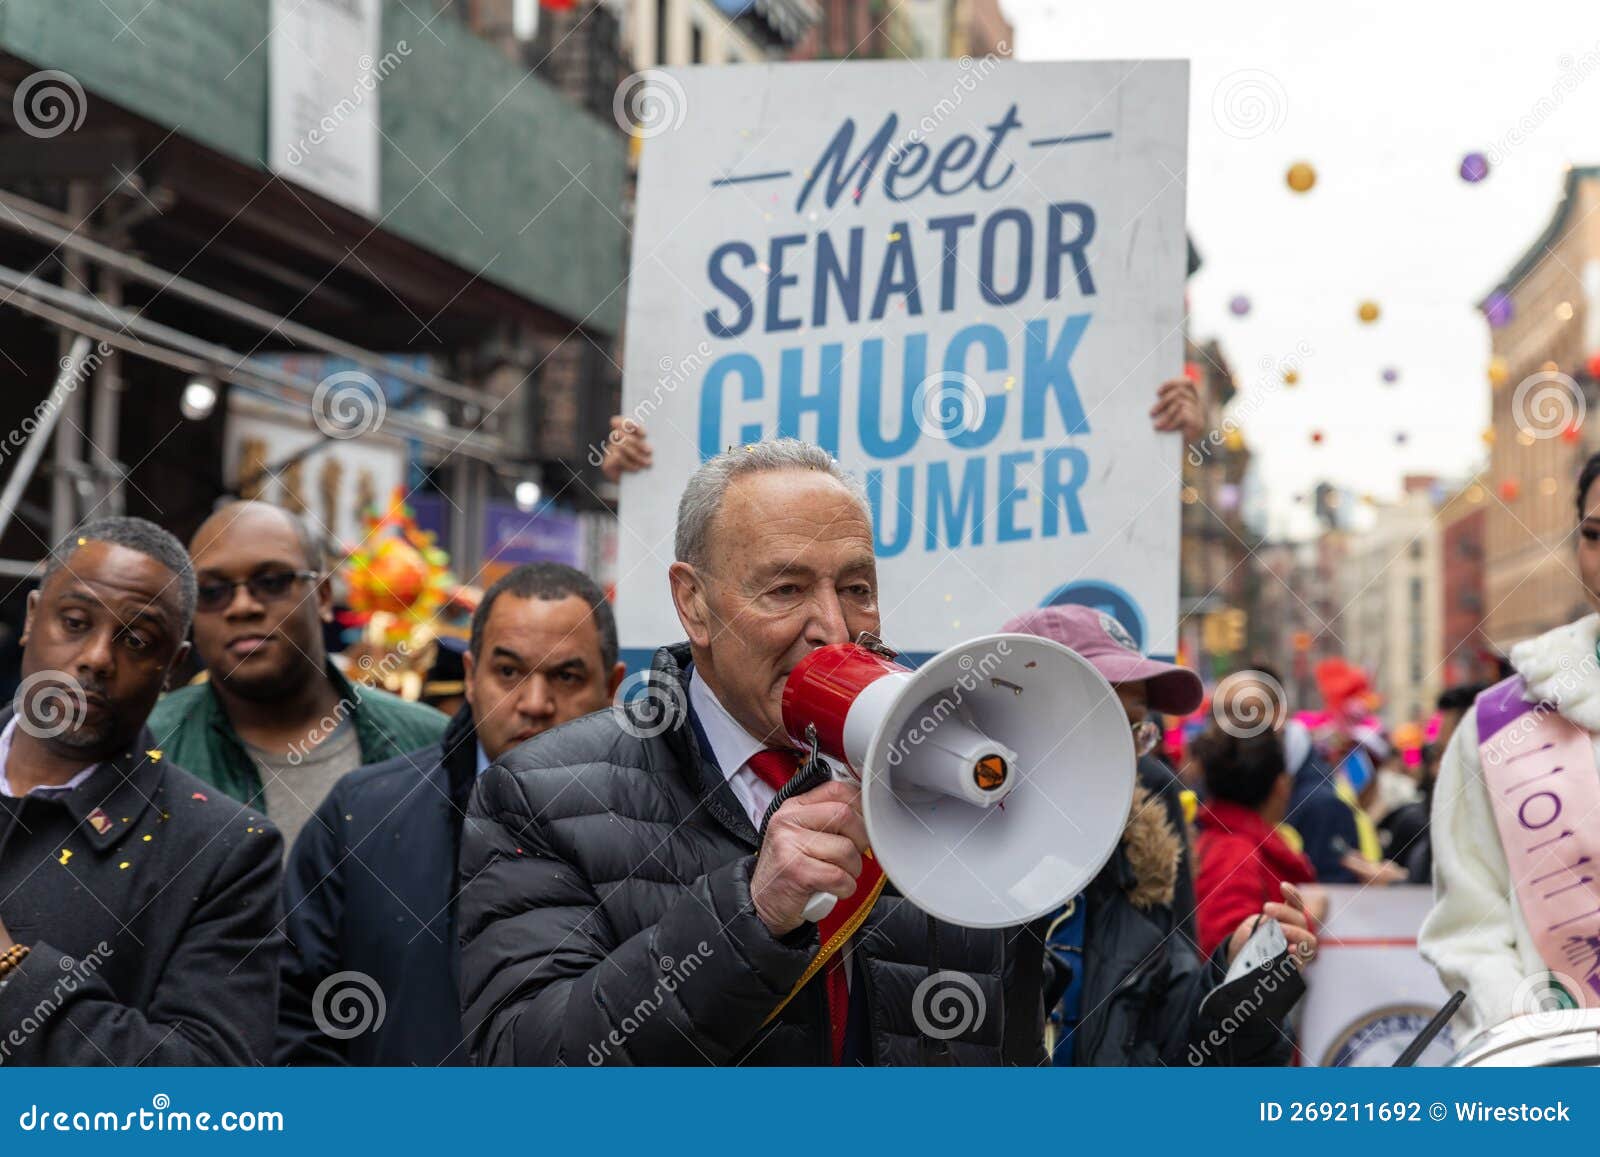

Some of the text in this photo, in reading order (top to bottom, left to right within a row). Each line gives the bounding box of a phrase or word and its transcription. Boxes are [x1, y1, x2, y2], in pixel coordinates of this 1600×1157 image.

[796, 103, 1024, 214] Meet
[704, 201, 1097, 339] SENATOR
[697, 313, 1093, 463] CHUCK
[865, 447, 1089, 559] UMER
